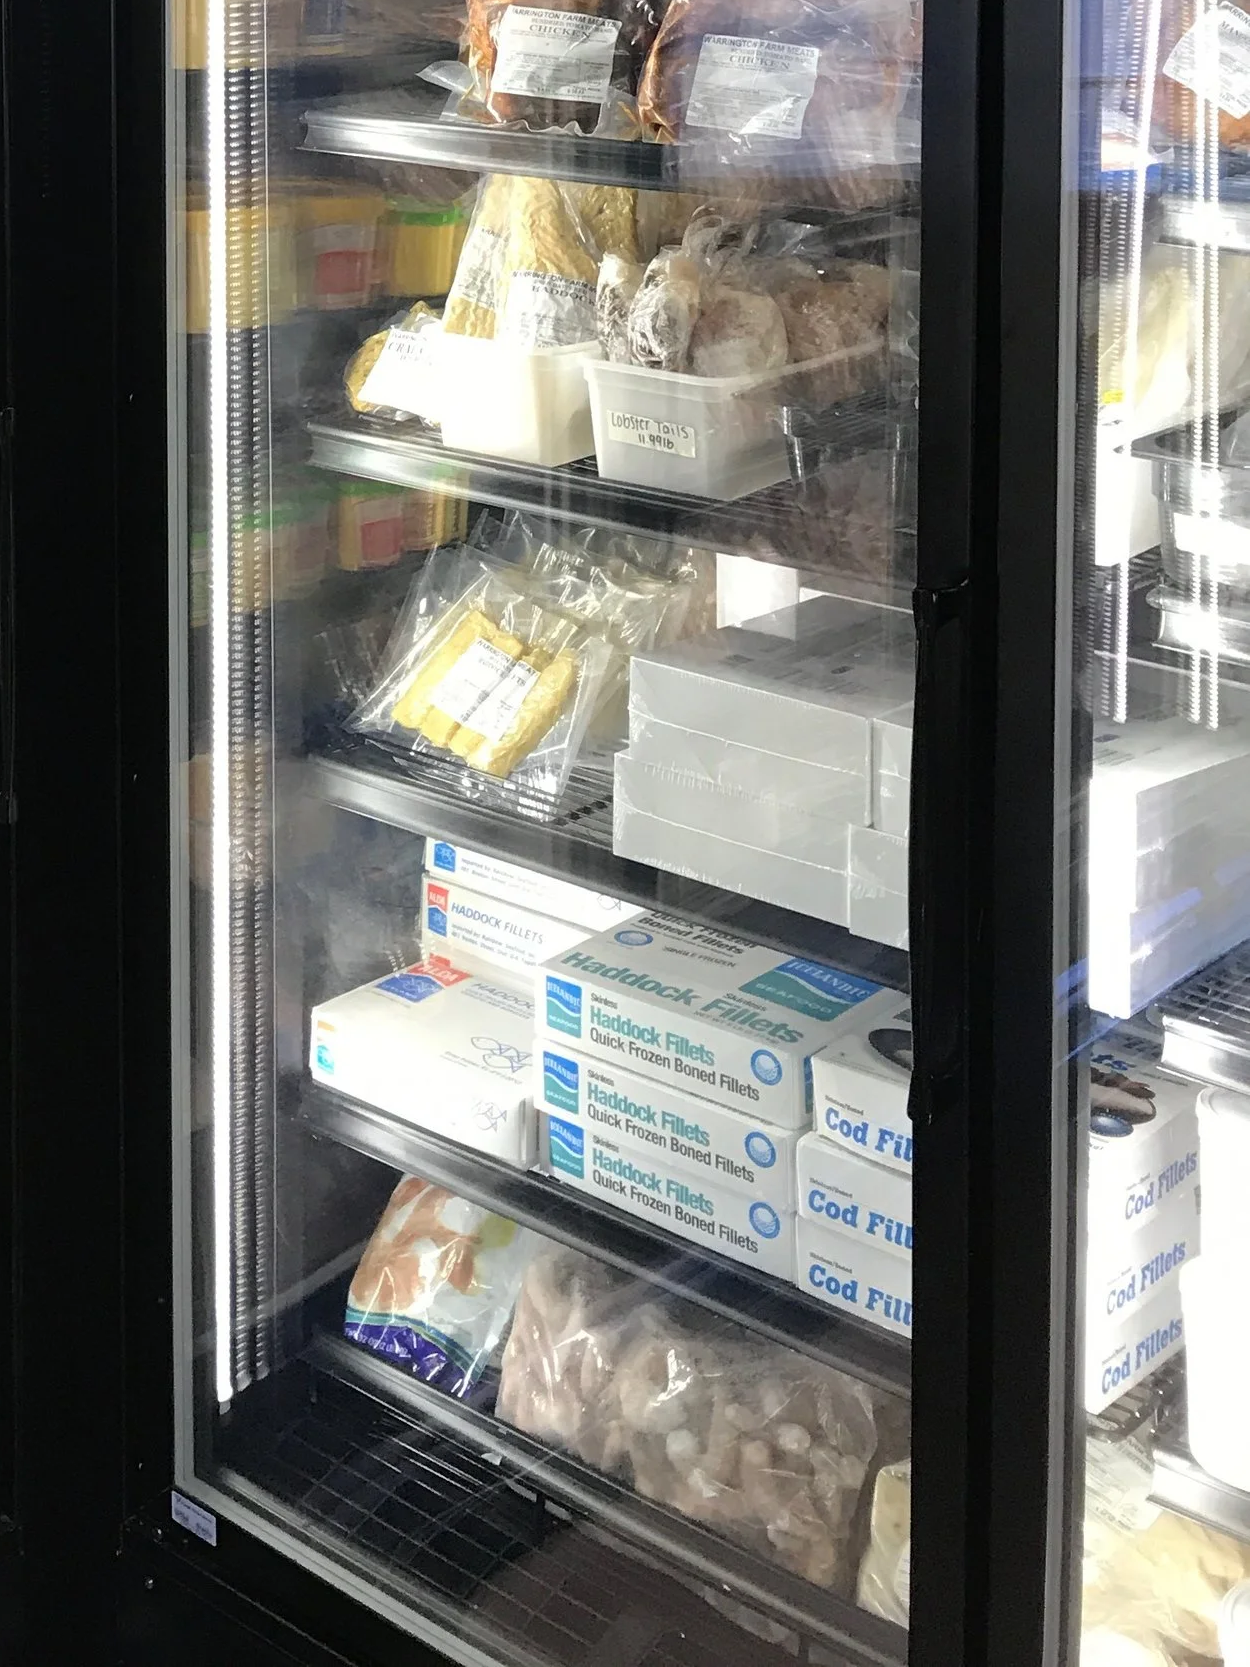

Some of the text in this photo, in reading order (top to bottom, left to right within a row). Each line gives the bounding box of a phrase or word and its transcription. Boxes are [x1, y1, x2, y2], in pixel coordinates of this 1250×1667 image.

[529, 24, 590, 38] CHICKEN
[562, 14, 586, 24] FARM
[587, 17, 617, 28] MEATS
[759, 41, 785, 52] FARM
[729, 54, 790, 70] CHICKEN
[451, 902, 544, 945] HADDOCK FILLETS
[638, 916, 744, 954] Boned Fillets
[561, 951, 702, 1007] Haddock
[700, 998, 804, 1044] Fillets
[787, 960, 871, 998] ICELANDIC
[590, 1005, 662, 1048] Haddock
[666, 1032, 715, 1066] Fillets
[590, 1026, 760, 1101] Quick Frozen Boned Fillets
[587, 1081, 711, 1147] Haddock Fillets
[825, 1106, 869, 1146] Cod
[587, 1103, 755, 1183] Quick Frozen Boned Fillets
[592, 1148, 715, 1216] Haddock Fillets
[1125, 1149, 1197, 1220] Cod Fillets
[592, 1169, 759, 1253] Quick Frozen Boned Fillets
[808, 1189, 859, 1228] Cod
[809, 1263, 859, 1304] Cod
[1107, 1241, 1186, 1315] Cod Fillets
[1101, 1317, 1183, 1395] Cod Fillets
